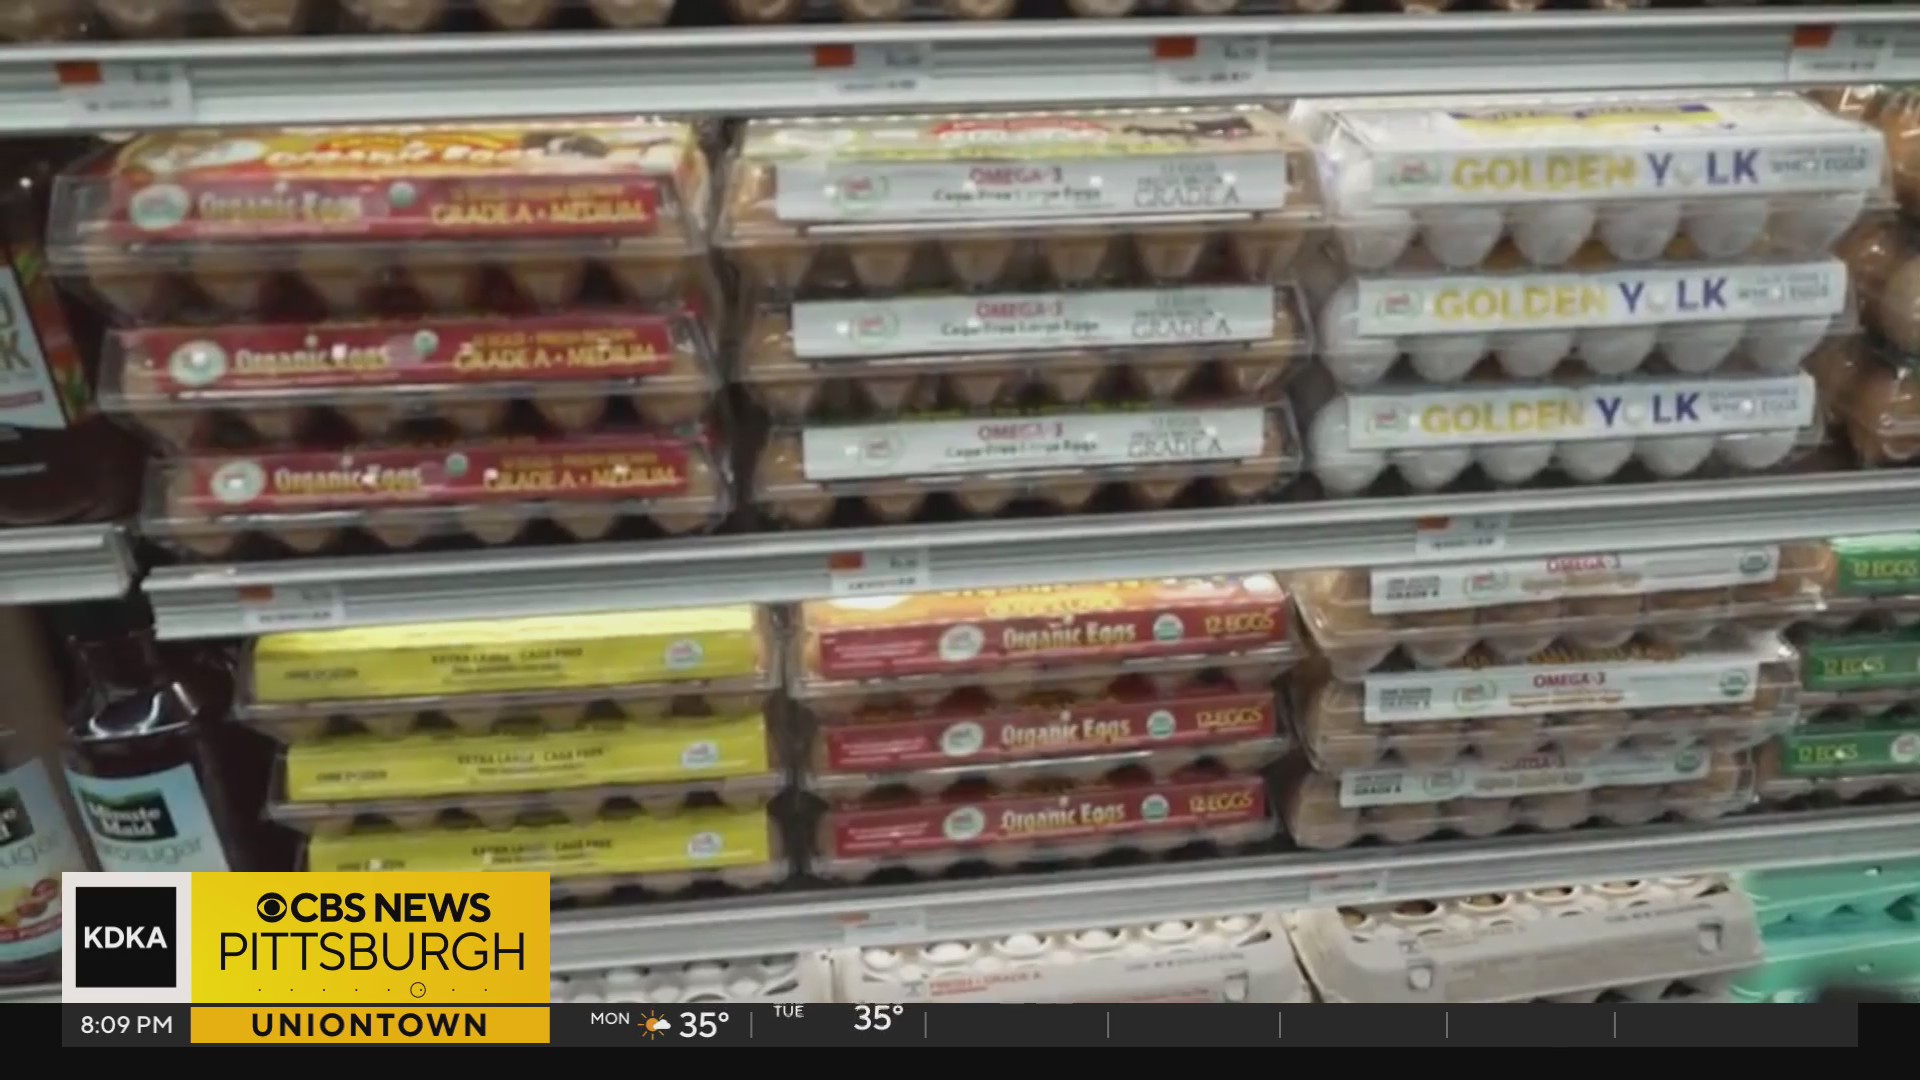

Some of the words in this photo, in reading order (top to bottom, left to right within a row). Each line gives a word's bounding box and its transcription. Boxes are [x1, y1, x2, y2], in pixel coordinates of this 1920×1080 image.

[1452, 152, 1638, 190] GOLDEN
[201, 181, 294, 222] Organic
[302, 191, 362, 225] Eggs
[430, 203, 506, 225] GRADE
[514, 203, 534, 224] A
[549, 197, 648, 223] MEDIUM
[1432, 285, 1609, 322] GOLDEN
[235, 333, 328, 376] Organic
[454, 347, 528, 371] GRADE
[567, 343, 656, 368] MEDIUM
[1419, 398, 1585, 433] GOLDEN
[273, 454, 362, 494] Organic
[1003, 614, 1081, 650] Organic
[1086, 621, 1137, 645] Eggs
[1204, 616, 1222, 635] 12
[1225, 610, 1276, 633] EGGS
[1533, 671, 1606, 688] OMEGA-3
[1002, 710, 1078, 746] Organic
[1083, 716, 1131, 741] Eggs
[1216, 707, 1263, 728] EGGS
[89, 801, 161, 820] Minute
[1001, 796, 1076, 831] Organic
[1081, 802, 1126, 827] Eggs
[1207, 791, 1252, 810] EGGS
[100, 817, 156, 835] Maid
